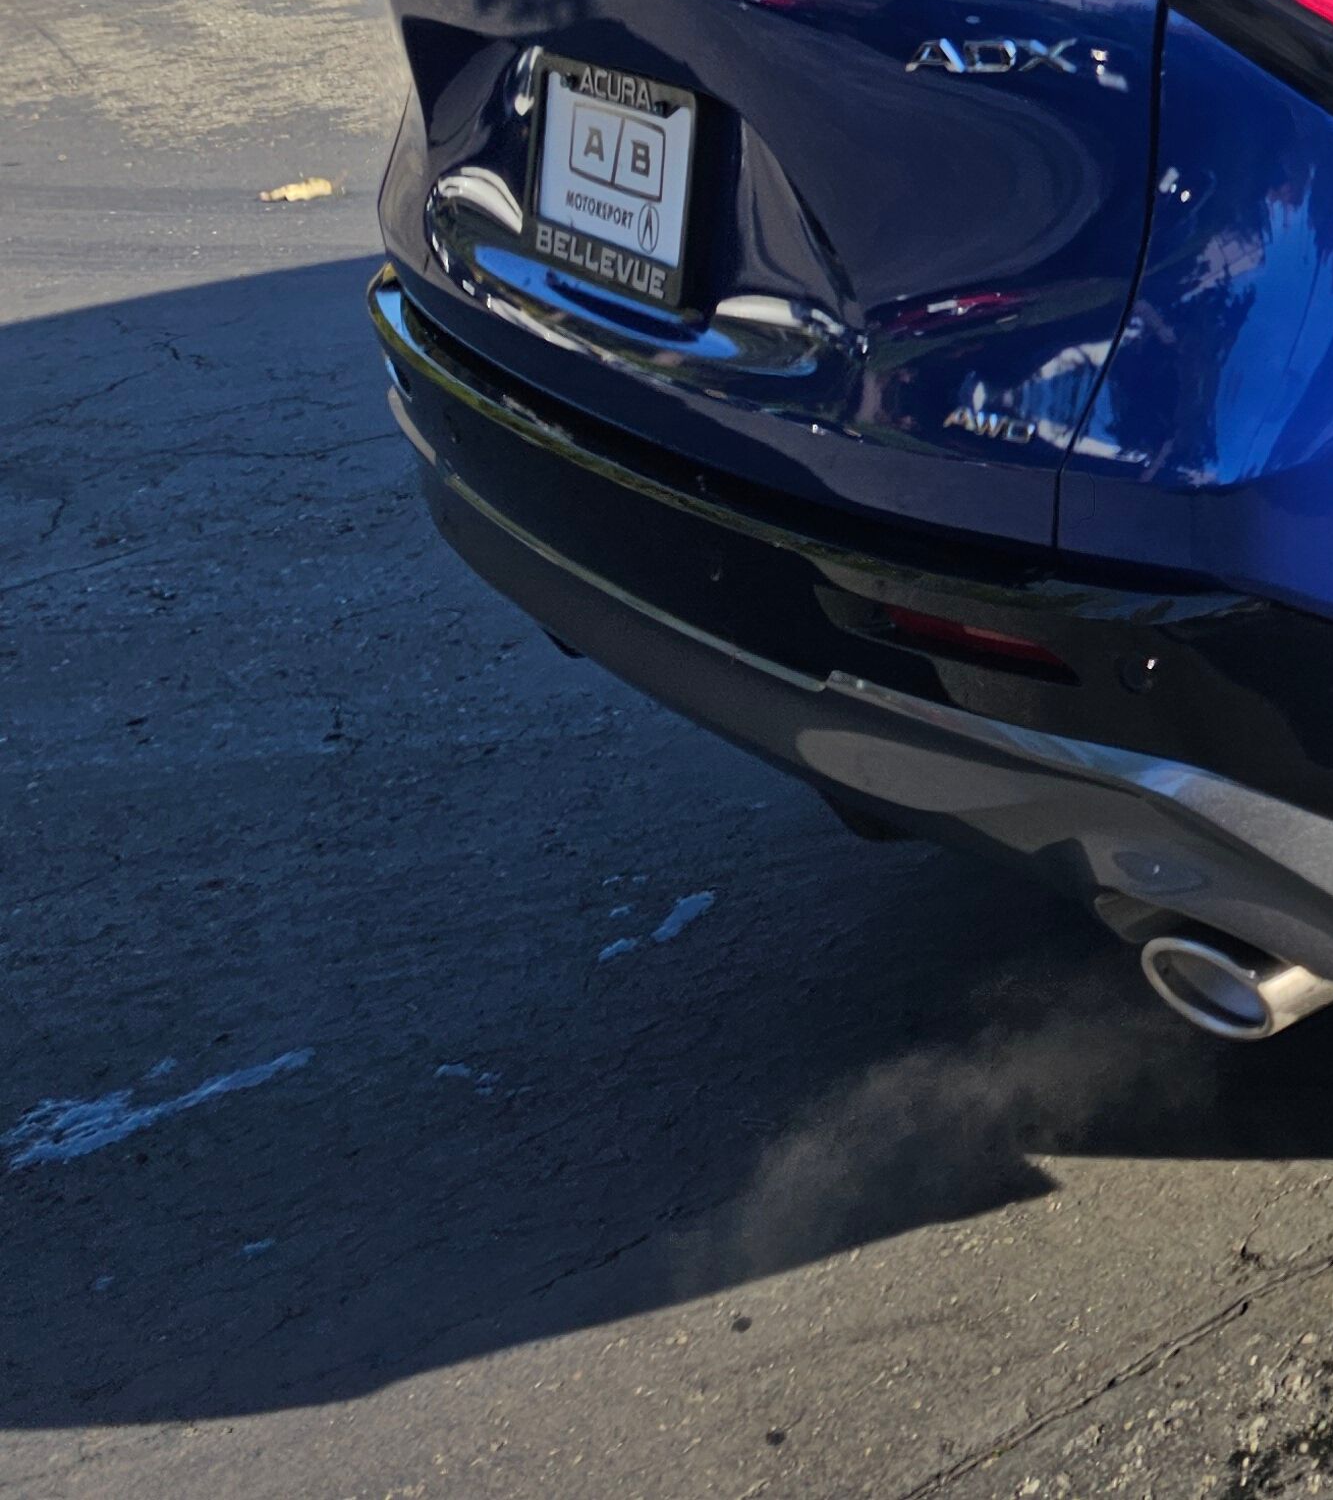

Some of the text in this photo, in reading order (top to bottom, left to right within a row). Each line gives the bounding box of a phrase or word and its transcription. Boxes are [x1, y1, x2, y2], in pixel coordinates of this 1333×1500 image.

[905, 37, 1078, 74] ADX
[579, 66, 652, 107] ACURA
[584, 126, 651, 178] A B
[565, 190, 634, 230] MOTORSPORT
[536, 222, 667, 300] BELLEVUE
[943, 406, 1036, 444] AWD
